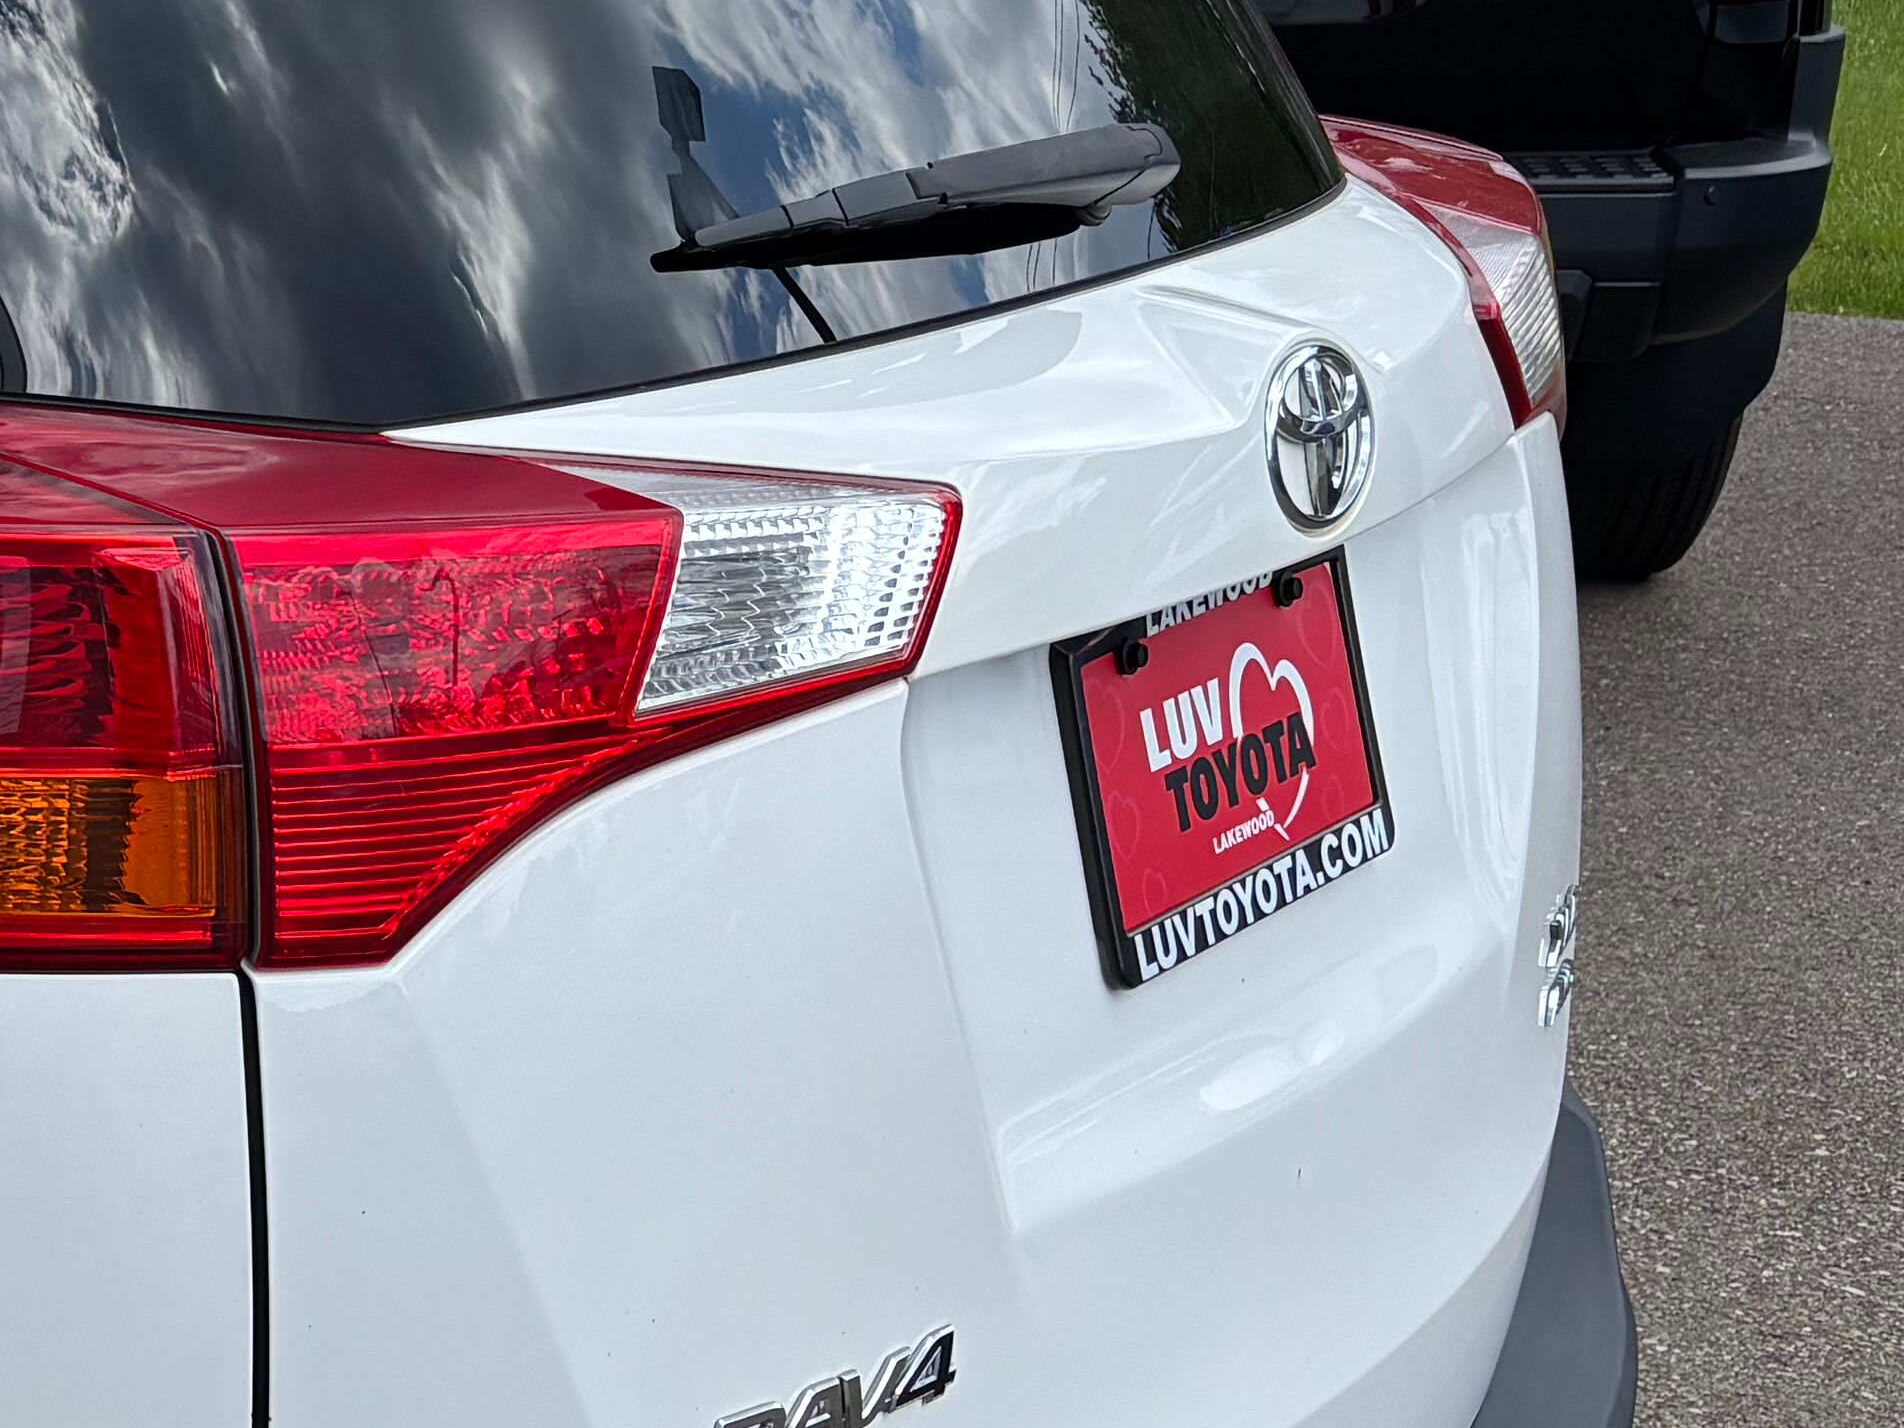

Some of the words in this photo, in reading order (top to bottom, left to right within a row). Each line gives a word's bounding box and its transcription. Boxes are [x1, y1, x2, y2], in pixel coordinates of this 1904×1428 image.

[1139, 677, 1223, 772] LUV
[1165, 712, 1317, 833] TOYOTA
[1212, 808, 1275, 855] LAKEWOOD
[1133, 808, 1388, 982] LUVTOYOTA.COM
